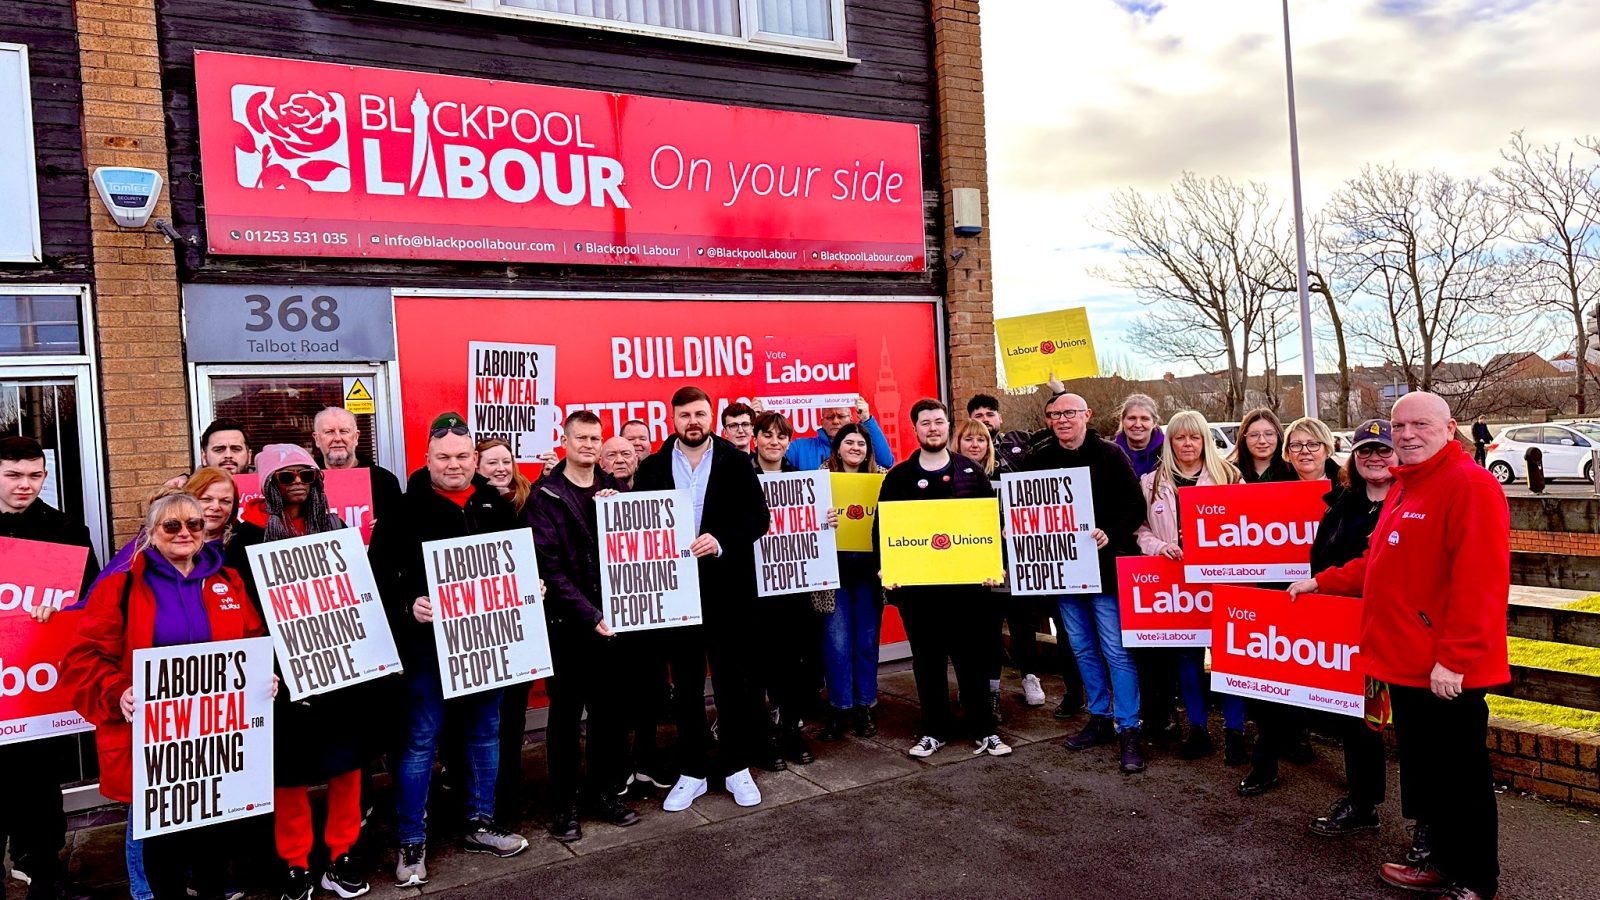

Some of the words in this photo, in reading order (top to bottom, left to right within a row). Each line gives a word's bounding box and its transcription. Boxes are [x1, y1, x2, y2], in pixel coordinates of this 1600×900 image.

[362, 137, 632, 209] LABOUR
[650, 145, 712, 191] On
[723, 161, 822, 207] your
[832, 160, 903, 203] side
[245, 230, 289, 242] 01253
[293, 232, 318, 243] 531
[322, 233, 348, 245] 035
[384, 234, 556, 252] info@blackpoollabour.com
[586, 243, 640, 256] Blackpool
[642, 245, 680, 256] Labour
[707, 247, 798, 261] @BlackpoolLabour
[820, 251, 914, 263] BlackpoolLabour.com
[244, 294, 341, 333] 368
[246, 339, 297, 353] Talbot
[301, 339, 339, 353] Road
[611, 335, 753, 379] BUILDING
[765, 351, 787, 360] Vote
[1007, 345, 1039, 356] Labour
[1055, 338, 1087, 349] Unions
[475, 349, 539, 379] LABOUR'S
[765, 359, 856, 384] Labour
[475, 377, 505, 404] NEW
[508, 379, 539, 406] DEAL
[540, 398, 549, 406] FOR
[474, 405, 536, 432] WORKING
[763, 478, 816, 508] ABOUR'S
[1008, 476, 1074, 507] LABOUR'S
[603, 498, 675, 532] LABOUR'S
[789, 506, 820, 532] DEAL
[1010, 507, 1040, 535] NEW
[1044, 505, 1079, 533] DEAL
[1196, 504, 1226, 515] Vote
[606, 532, 639, 563] NEW
[643, 529, 680, 560] DEAL
[681, 549, 691, 558] FOR
[761, 533, 819, 563] WORKING
[888, 536, 929, 547] Labour
[952, 534, 993, 545] Unions
[1013, 533, 1078, 563] WORKING
[257, 540, 347, 588] LABOUR'S
[432, 540, 516, 584] LABOUR'S
[762, 561, 809, 592] PEOPLE
[1016, 562, 1066, 591] PEOPLE
[1200, 568, 1222, 577] Vote
[1231, 567, 1266, 576] Labour
[607, 560, 678, 595] WORKING
[1132, 573, 1160, 583] Vote
[267, 582, 312, 623] NEW
[311, 573, 361, 612] DEAL
[361, 592, 373, 603] FOR
[438, 580, 476, 620] NEW
[480, 574, 523, 612] DEAL
[524, 595, 536, 605] FOR
[610, 593, 665, 627] PEOPLE
[1131, 584, 1213, 613] Labo
[1227, 606, 1257, 621] Vote
[277, 607, 367, 658] WORKING
[441, 608, 525, 655] WORKING
[1136, 633, 1156, 641] Vote
[1164, 633, 1197, 641] Labour
[1226, 621, 1360, 672] Labour
[145, 651, 247, 701] LABOUR'S
[288, 645, 361, 694] PEOPLE
[447, 645, 513, 692] PEOPLE
[1225, 677, 1248, 689] Vote
[1255, 682, 1291, 697] Labour
[1308, 693, 1360, 709] labour.org.uk
[144, 698, 193, 744] NEW
[199, 692, 249, 736] DEAL
[251, 716, 265, 729] FOR
[144, 731, 244, 787] WORKING
[145, 776, 223, 831] PEOPLE
